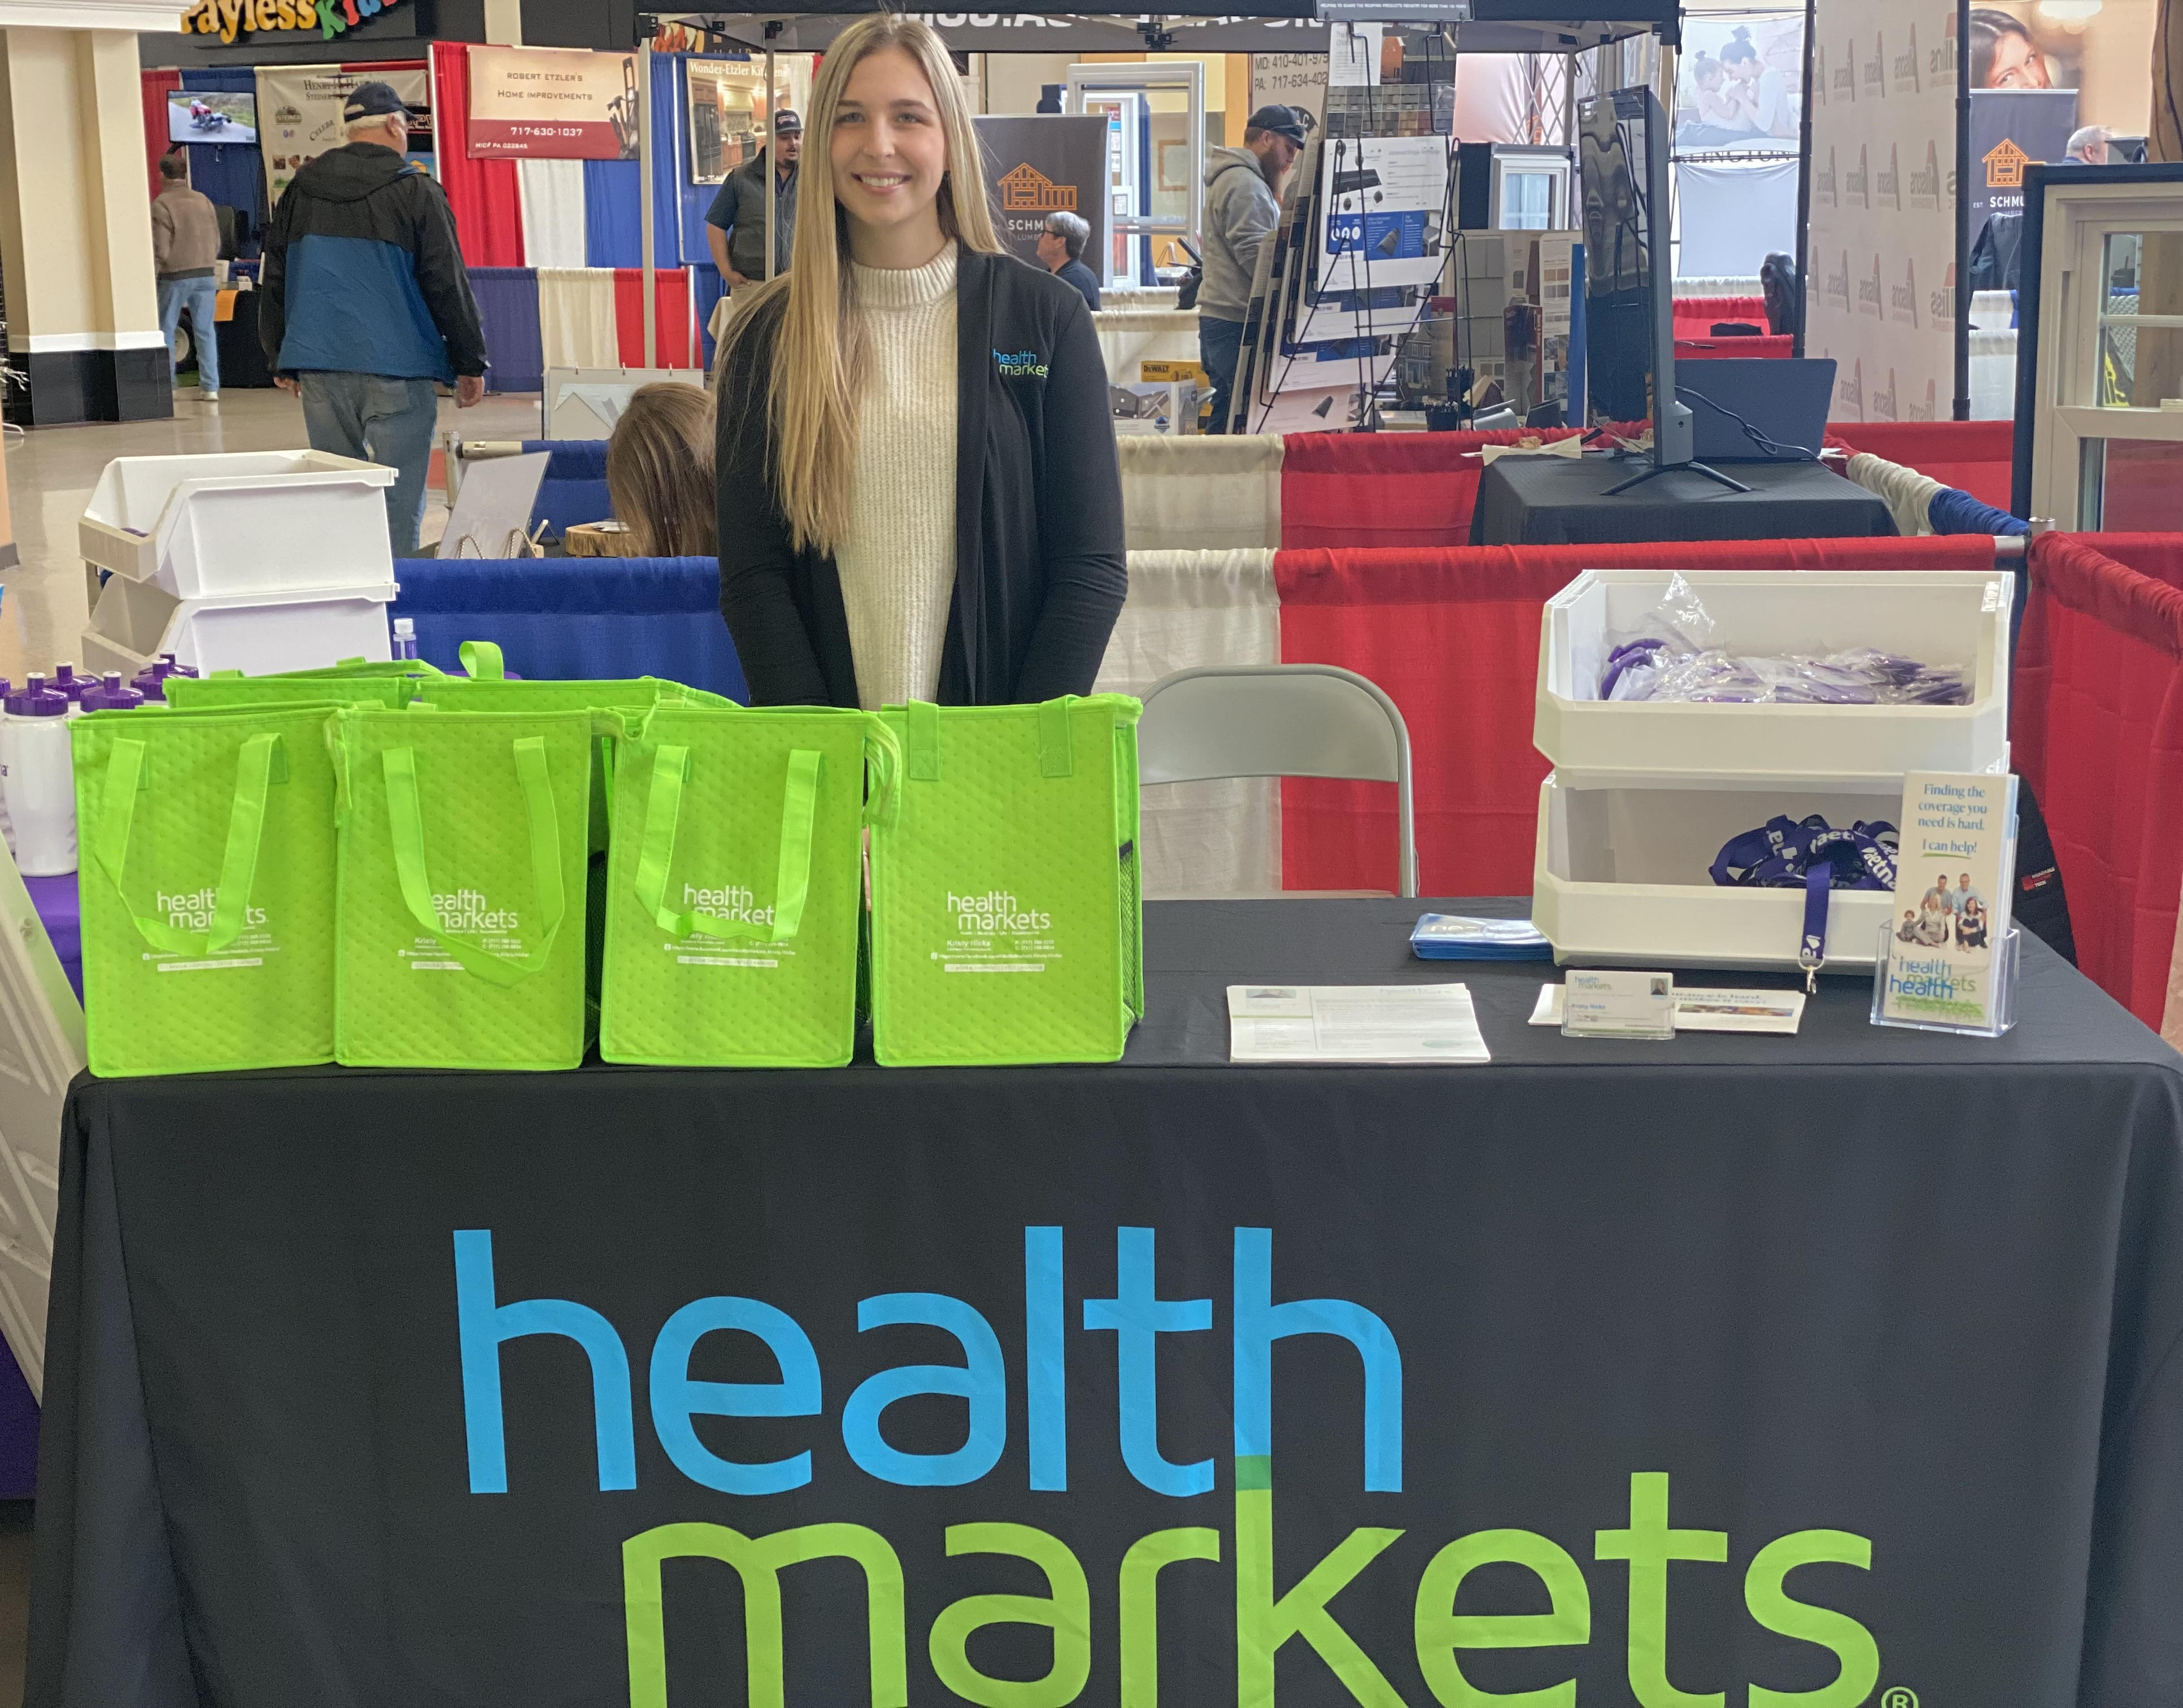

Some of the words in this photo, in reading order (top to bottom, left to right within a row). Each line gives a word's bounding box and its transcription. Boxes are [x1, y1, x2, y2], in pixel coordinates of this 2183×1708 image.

[690, 62, 750, 75] Wonder-Etzler
[751, 65, 787, 77] Kitens
[1254, 77, 1266, 90] PA:
[511, 127, 582, 136] 717-630-1037
[993, 348, 1036, 364] health
[1924, 783, 1965, 799] Finding
[1968, 786, 1985, 798] the
[1918, 801, 1966, 816] coverage
[1967, 804, 1987, 816] you
[1918, 817, 1945, 827] need
[1947, 817, 1955, 828] is
[1958, 818, 1985, 830] hard.
[1923, 839, 1926, 850] I
[1929, 842, 1947, 851] can
[1950, 840, 1977, 856] help!
[157, 888, 220, 912] healt
[432, 889, 486, 911] ealth
[683, 883, 753, 907] health
[947, 891, 1016, 913] health
[169, 905, 268, 929] marts
[694, 905, 775, 926] market
[959, 911, 1051, 930] markets
[1899, 956, 1952, 977] health
[1889, 974, 1953, 999] health
[452, 1226, 1405, 1494] health
[621, 1471, 1881, 1708] markets
